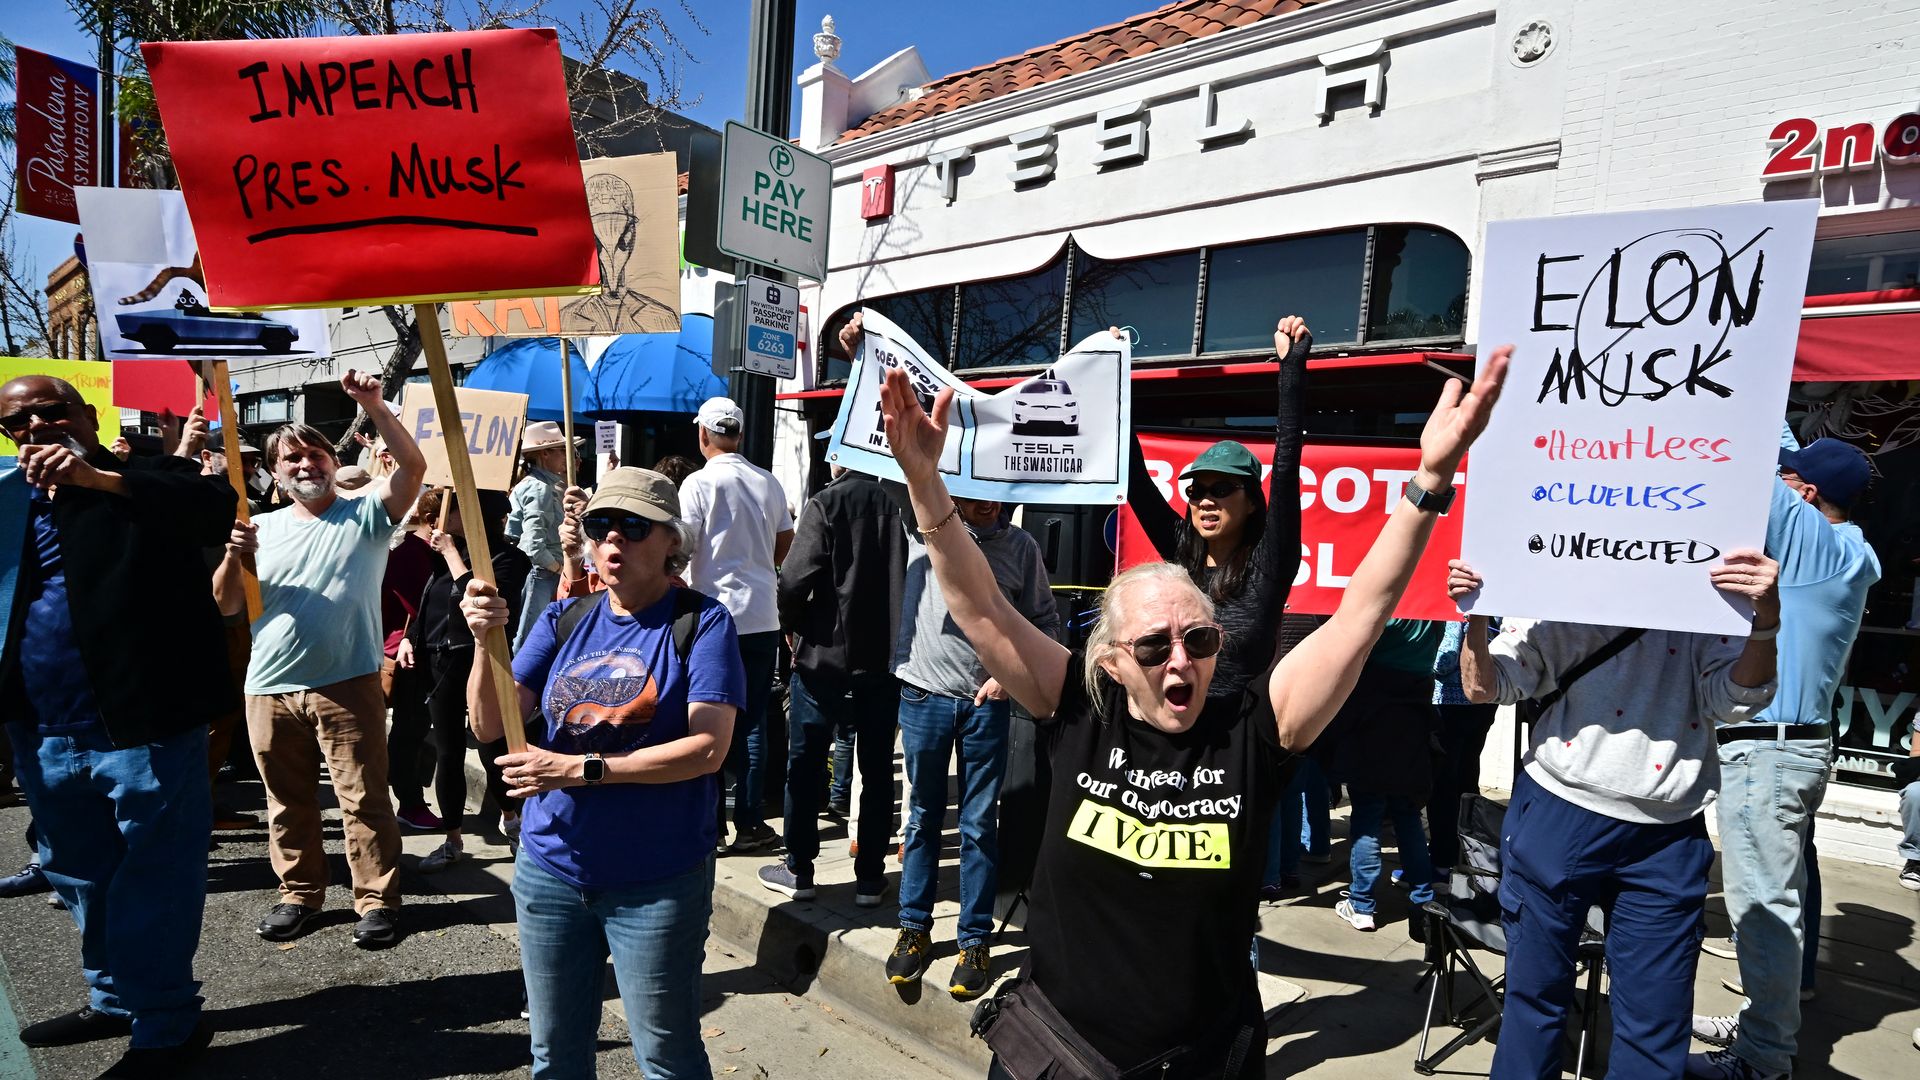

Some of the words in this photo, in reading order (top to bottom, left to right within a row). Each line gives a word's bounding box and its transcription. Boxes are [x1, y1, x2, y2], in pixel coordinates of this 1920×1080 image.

[238, 48, 479, 123] IMPEACH
[26, 72, 75, 192] Pasadena
[73, 84, 91, 185] SYMPHONY
[928, 39, 1390, 201] TESLA
[776, 149, 790, 171] P
[233, 154, 370, 219] PRES.
[754, 170, 806, 210] PAY
[742, 196, 813, 243] HERE
[750, 300, 761, 308] PAY
[761, 303, 775, 311] WITH
[775, 306, 785, 314] THE
[753, 307, 792, 323] PASSPORT
[755, 316, 789, 331] PARKING
[762, 331, 781, 341] ZONE
[757, 339, 785, 354] 6263
[1537, 345, 1735, 406] MUSK
[1012, 442, 1074, 455] TESLA
[1004, 455, 1022, 472] THE
[1023, 456, 1083, 474] SWASTICAR
[1548, 482, 1707, 511] CLUELESS
[1550, 532, 1721, 564] UNELECTED
[1076, 772, 1118, 798] our
[1192, 765, 1226, 789] for
[1082, 809, 1105, 839] I
[1115, 816, 1222, 862] VOTE.
